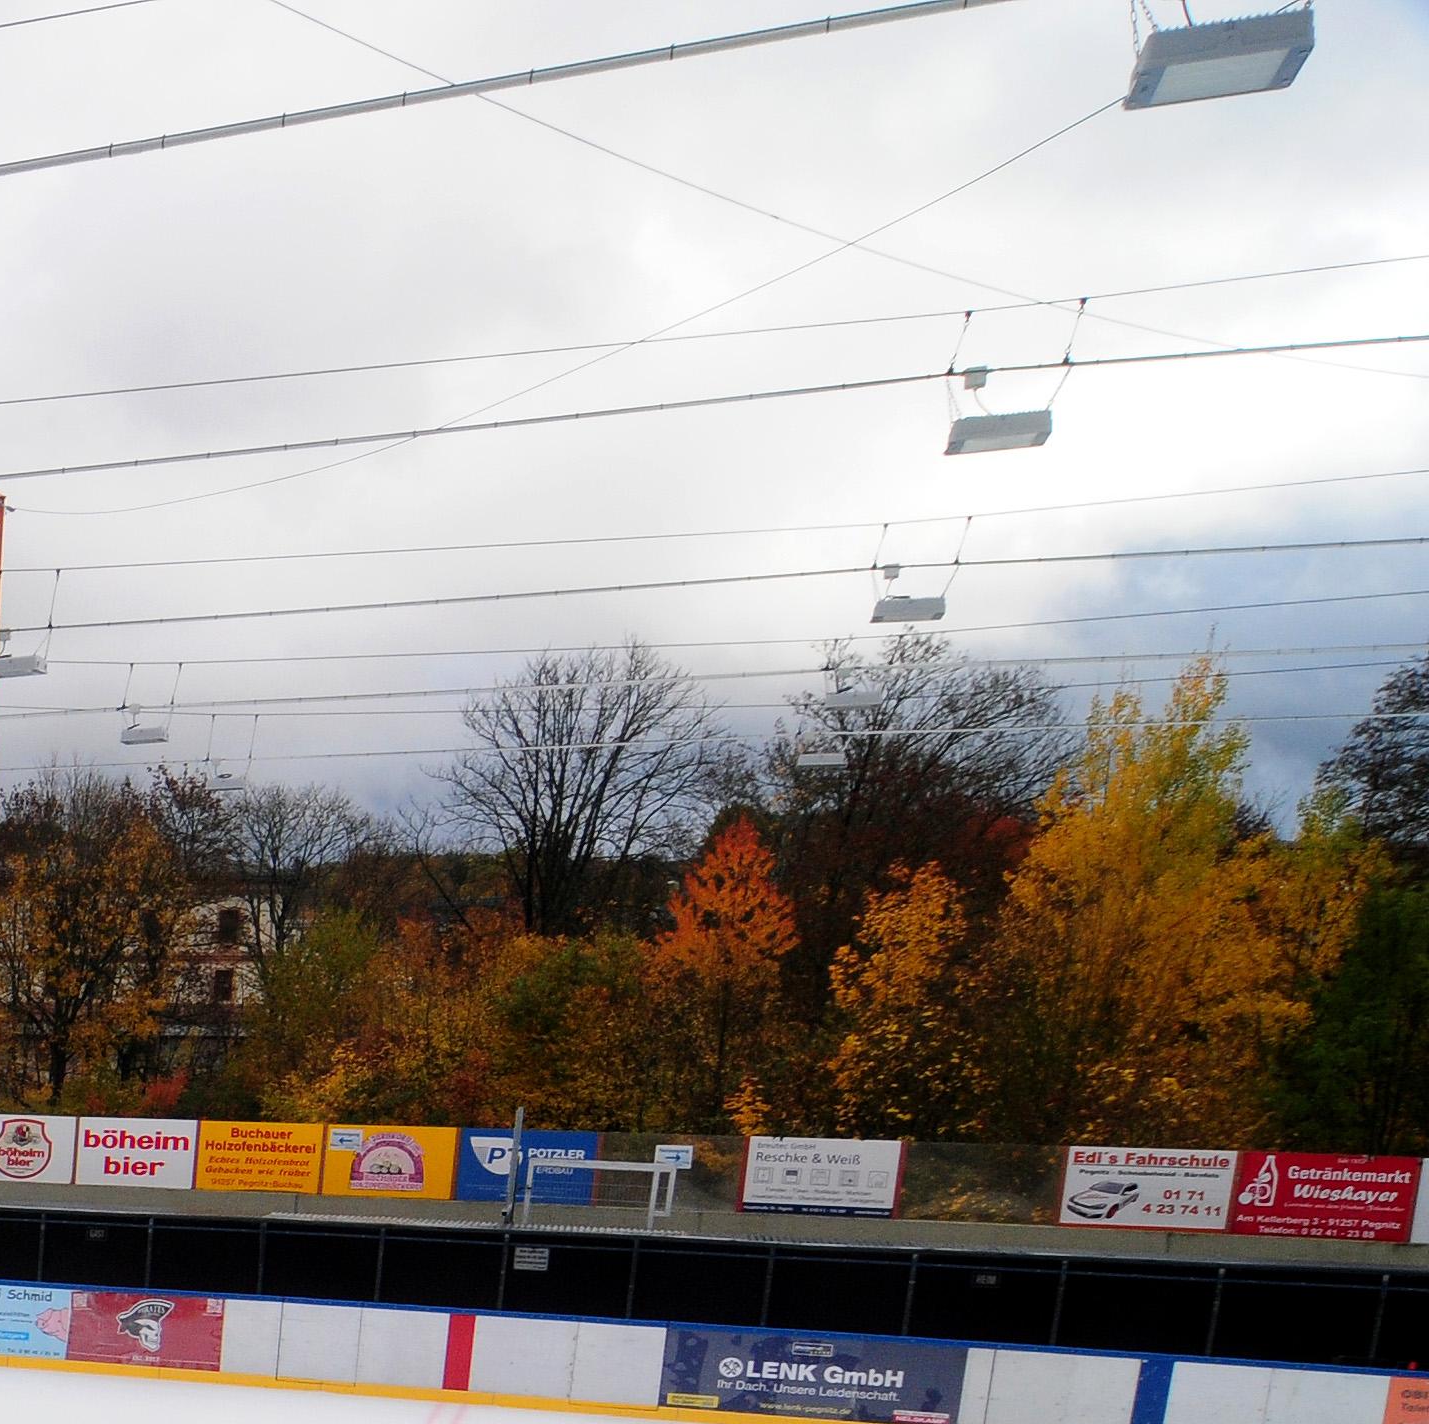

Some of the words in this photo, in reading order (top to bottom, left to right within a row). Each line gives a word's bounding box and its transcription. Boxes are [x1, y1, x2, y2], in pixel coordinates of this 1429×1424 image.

[84, 1128, 189, 1151] böheim
[231, 1127, 293, 1140] Buchauer
[205, 1140, 316, 1154] Holzofenbäckerei
[7, 1157, 34, 1167] bier
[756, 1152, 808, 1164] Reschke
[812, 1153, 822, 1164] &
[827, 1154, 861, 1165] Weiß
[1125, 1152, 1230, 1168] Fahrschule
[104, 1156, 165, 1176] bier
[205, 1166, 253, 1175] Gebacken
[1288, 1165, 1412, 1184] Getränkemarkt
[1163, 1190, 1180, 1200] 01
[1187, 1190, 1205, 1200] 71
[1142, 1204, 1151, 1213] 4
[1156, 1204, 1175, 1215] 23
[1181, 1205, 1198, 1215] 74
[1204, 1206, 1221, 1216] 11
[1237, 1214, 1254, 1222] Am
[1257, 1215, 1310, 1226] Kellerberg
[1328, 1218, 1358, 1227] 91257
[1361, 1219, 1401, 1230] Pegnitz
[1258, 1226, 1298, 1235] Telefon:
[7, 1289, 53, 1302] Schmid
[746, 1360, 816, 1382] LENK
[823, 1366, 904, 1388] GmbH
[717, 1379, 733, 1390] Ihr
[736, 1380, 769, 1393] Dach.
[773, 1383, 816, 1397] Unsere
[819, 1386, 901, 1401] Leidenschaft.
[760, 1402, 852, 1416] www.lenk-pegnitz.de
